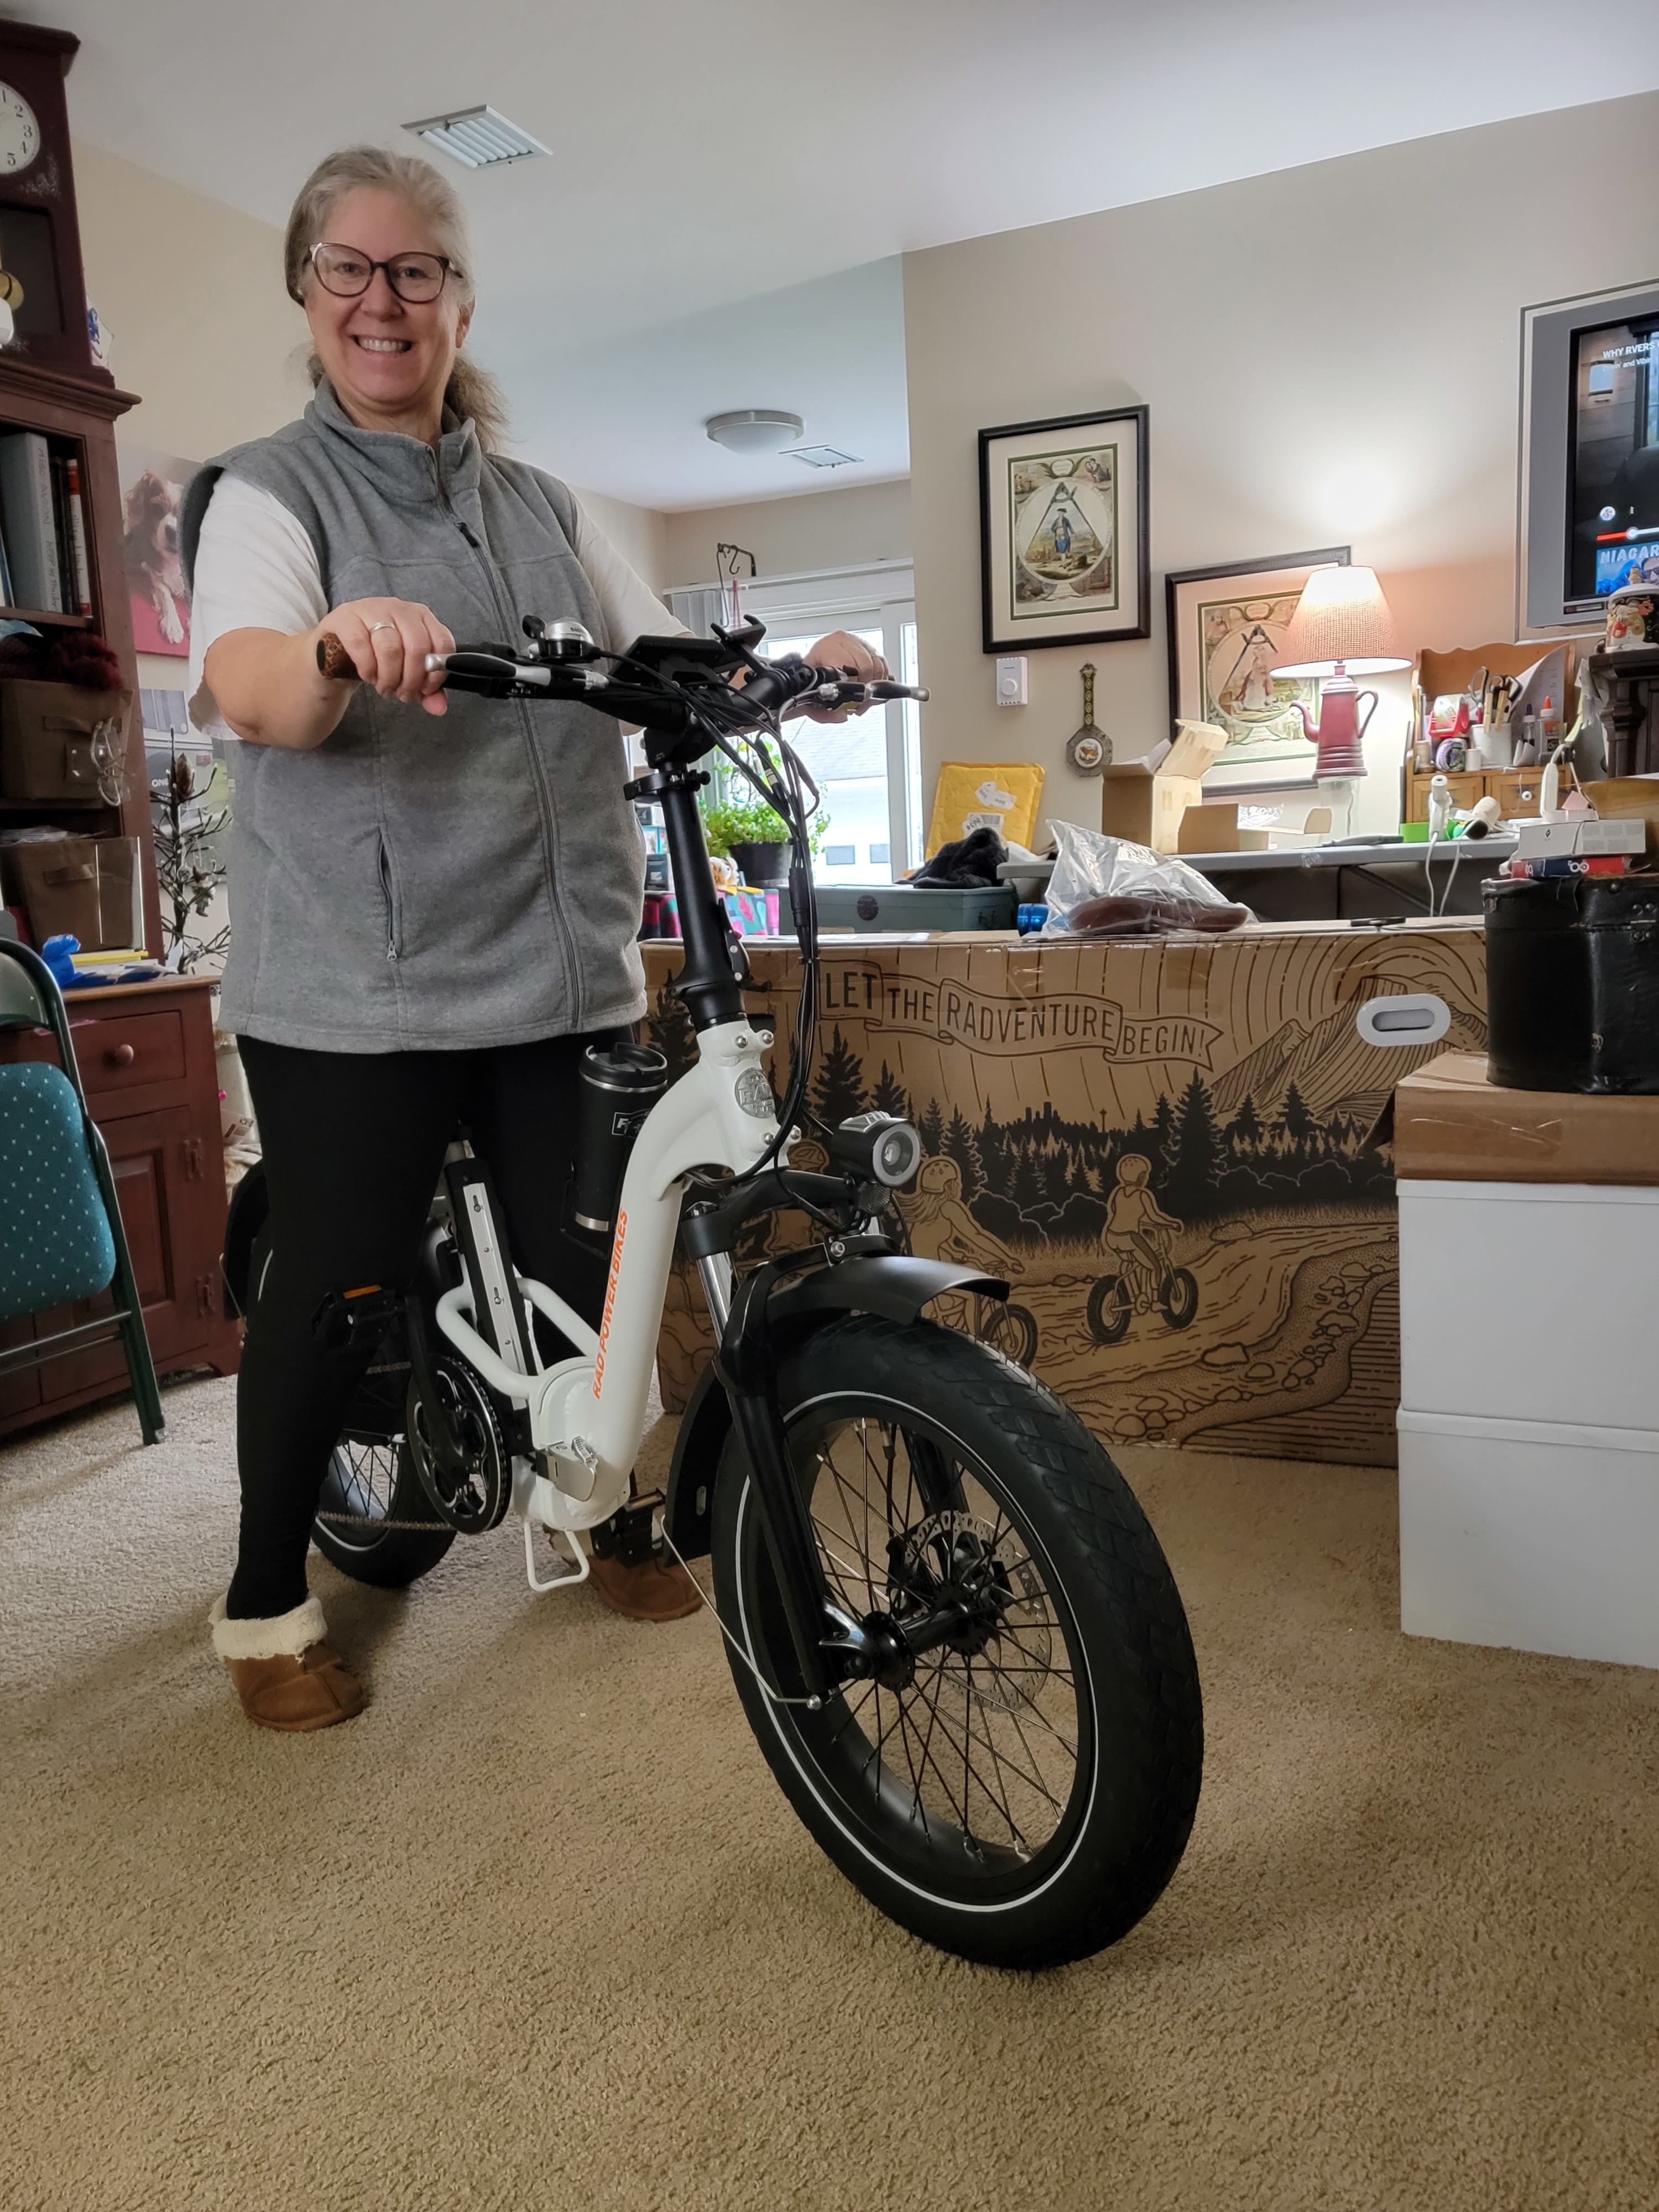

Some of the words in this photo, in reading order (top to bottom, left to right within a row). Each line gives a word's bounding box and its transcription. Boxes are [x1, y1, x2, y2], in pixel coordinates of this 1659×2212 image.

[2, 89, 6, 103] 1
[14, 105, 24, 118] 2
[23, 124, 33, 138] 3
[20, 141, 28, 154] 4
[7, 152, 16, 166] 5
[1603, 347, 1624, 358] WHY
[1625, 342, 1655, 354] RVERS
[1623, 359, 1635, 368] and
[826, 971, 877, 1010] LET
[887, 988, 935, 1023] THE
[946, 992, 1115, 1044] RADVENTURE
[1123, 1024, 1205, 1057] BEGIN!
[593, 1353, 605, 1400] RAD
[599, 1273, 618, 1354] POWER
[612, 1208, 628, 1275] BIKES
